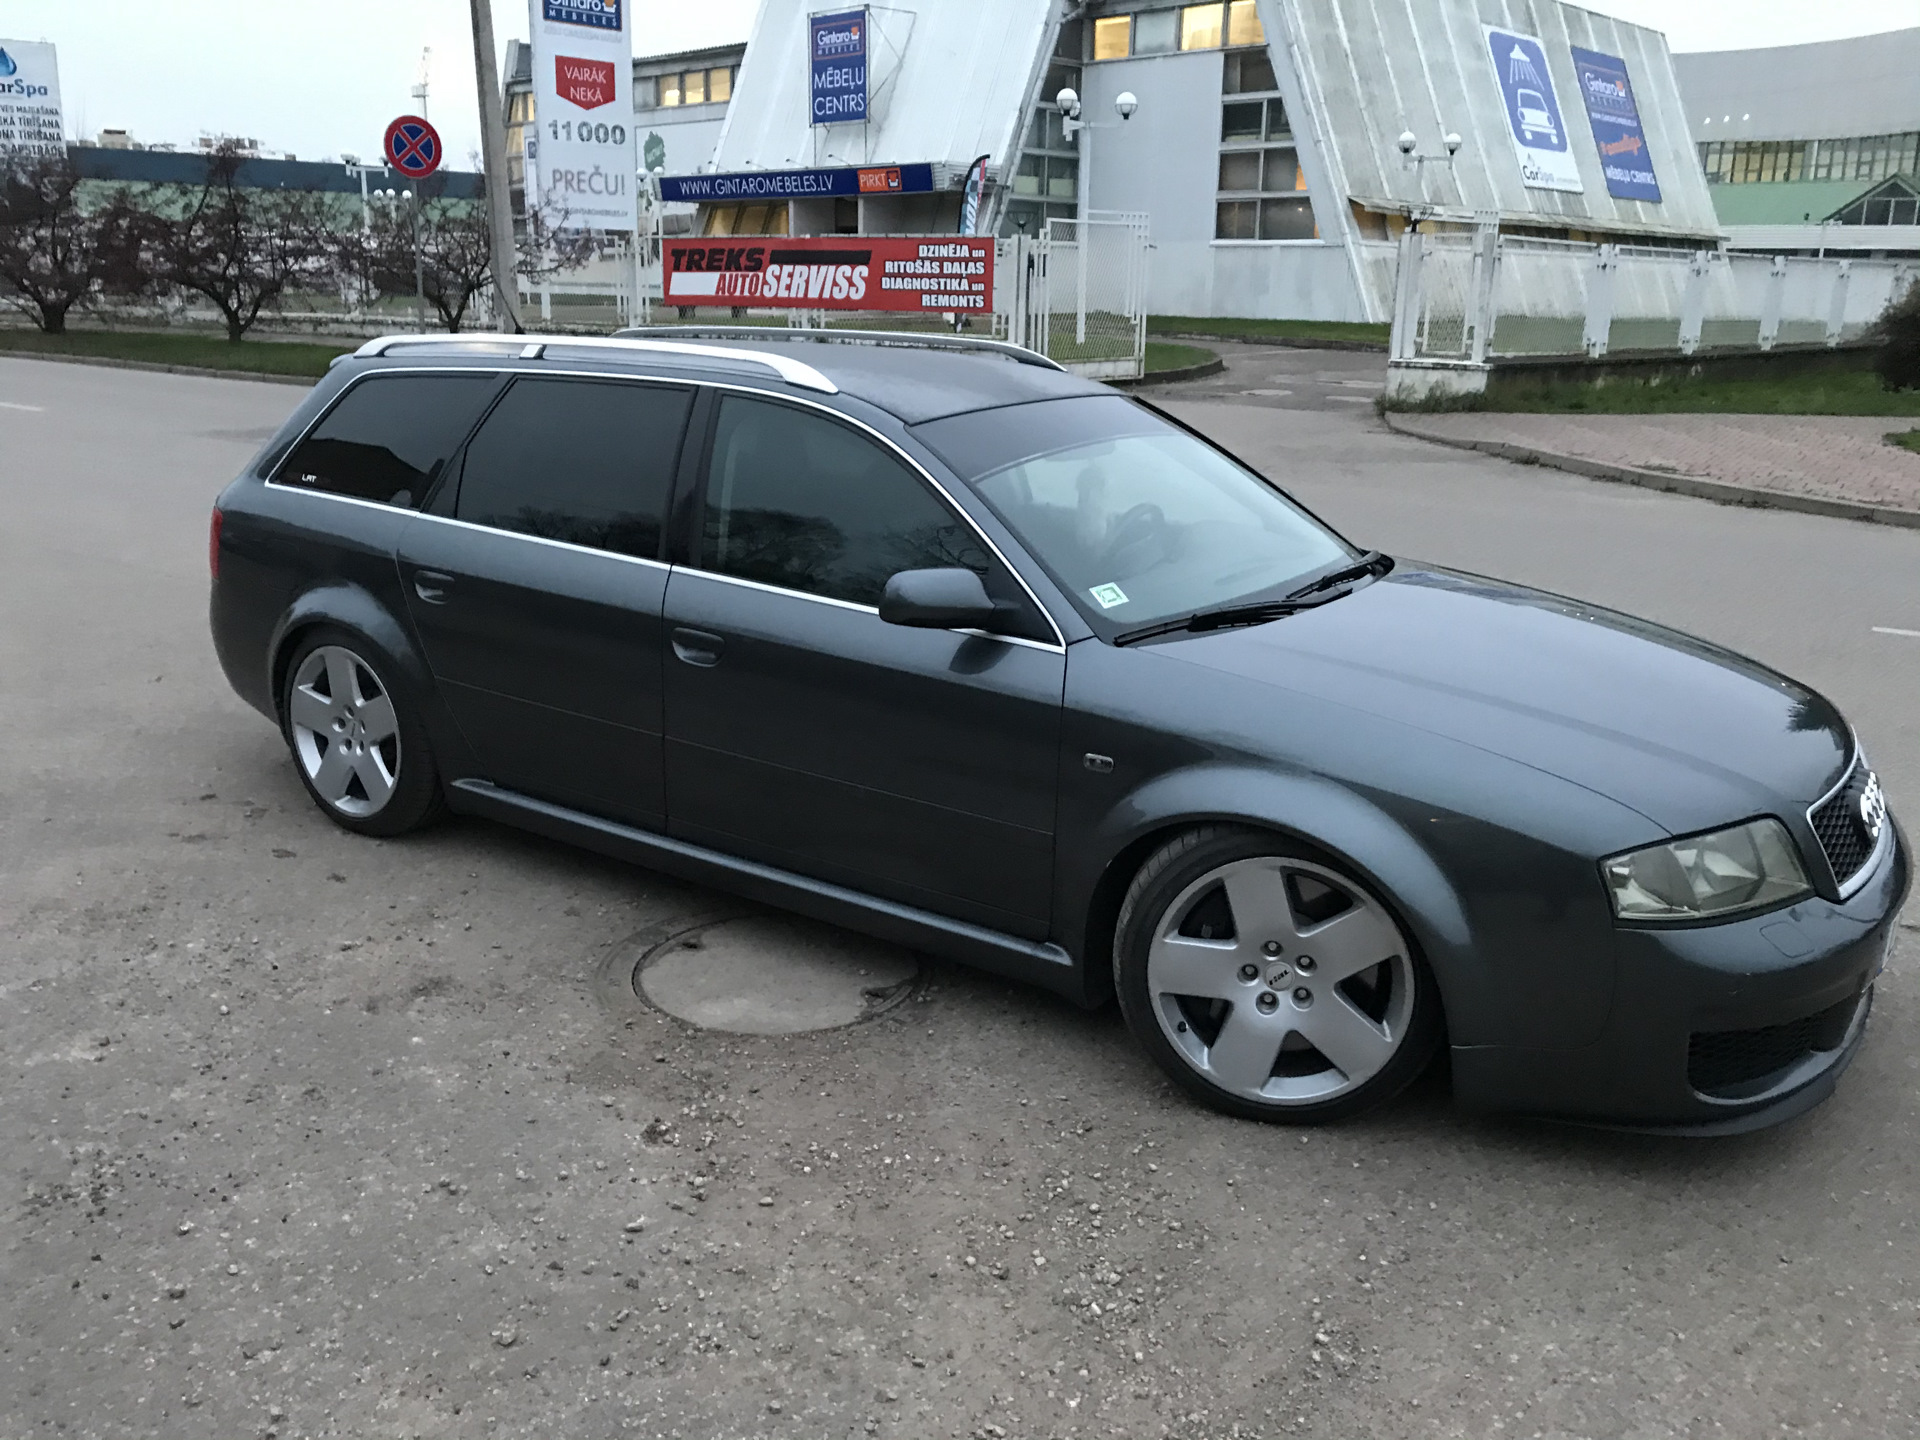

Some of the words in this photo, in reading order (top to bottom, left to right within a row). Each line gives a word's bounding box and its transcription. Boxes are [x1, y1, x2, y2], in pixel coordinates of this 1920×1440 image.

[817, 30, 850, 45] Gintaro
[564, 65, 607, 84] VAIRĀK
[814, 66, 864, 90] MĒBEĻU
[1585, 72, 1617, 96] Gintaro
[570, 86, 603, 103] NEKĀ
[814, 93, 864, 115] CENTRS
[552, 164, 625, 195] PREČU!
[859, 173, 886, 188] PIRKT
[671, 247, 766, 271] TREKS
[919, 243, 969, 258] DZINĒJA
[972, 249, 986, 258] un
[885, 259, 940, 274] RITOŠĀS
[943, 261, 985, 277] DAĻAS
[881, 276, 969, 291] DIAGNOSTIKA
[971, 282, 985, 291] un
[922, 294, 985, 308] REMONTS
